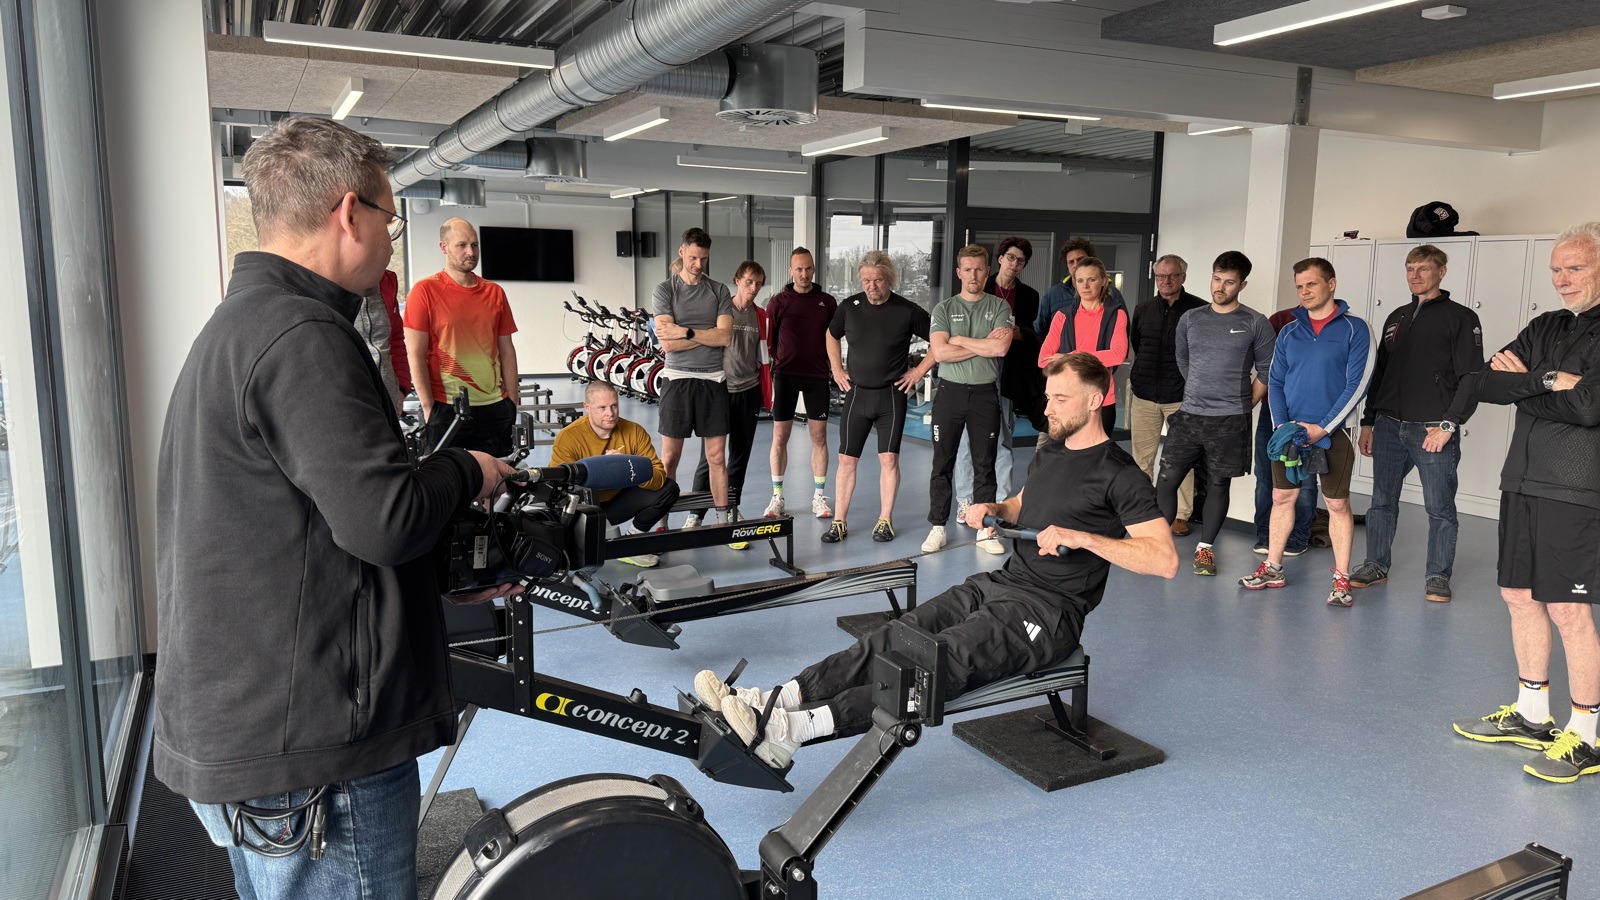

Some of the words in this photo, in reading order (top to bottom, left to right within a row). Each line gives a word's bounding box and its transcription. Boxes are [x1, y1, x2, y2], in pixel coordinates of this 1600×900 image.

[535, 551, 553, 564] SONY
[530, 585, 591, 611] oncept
[571, 704, 673, 741] concept
[673, 729, 690, 745] 2
